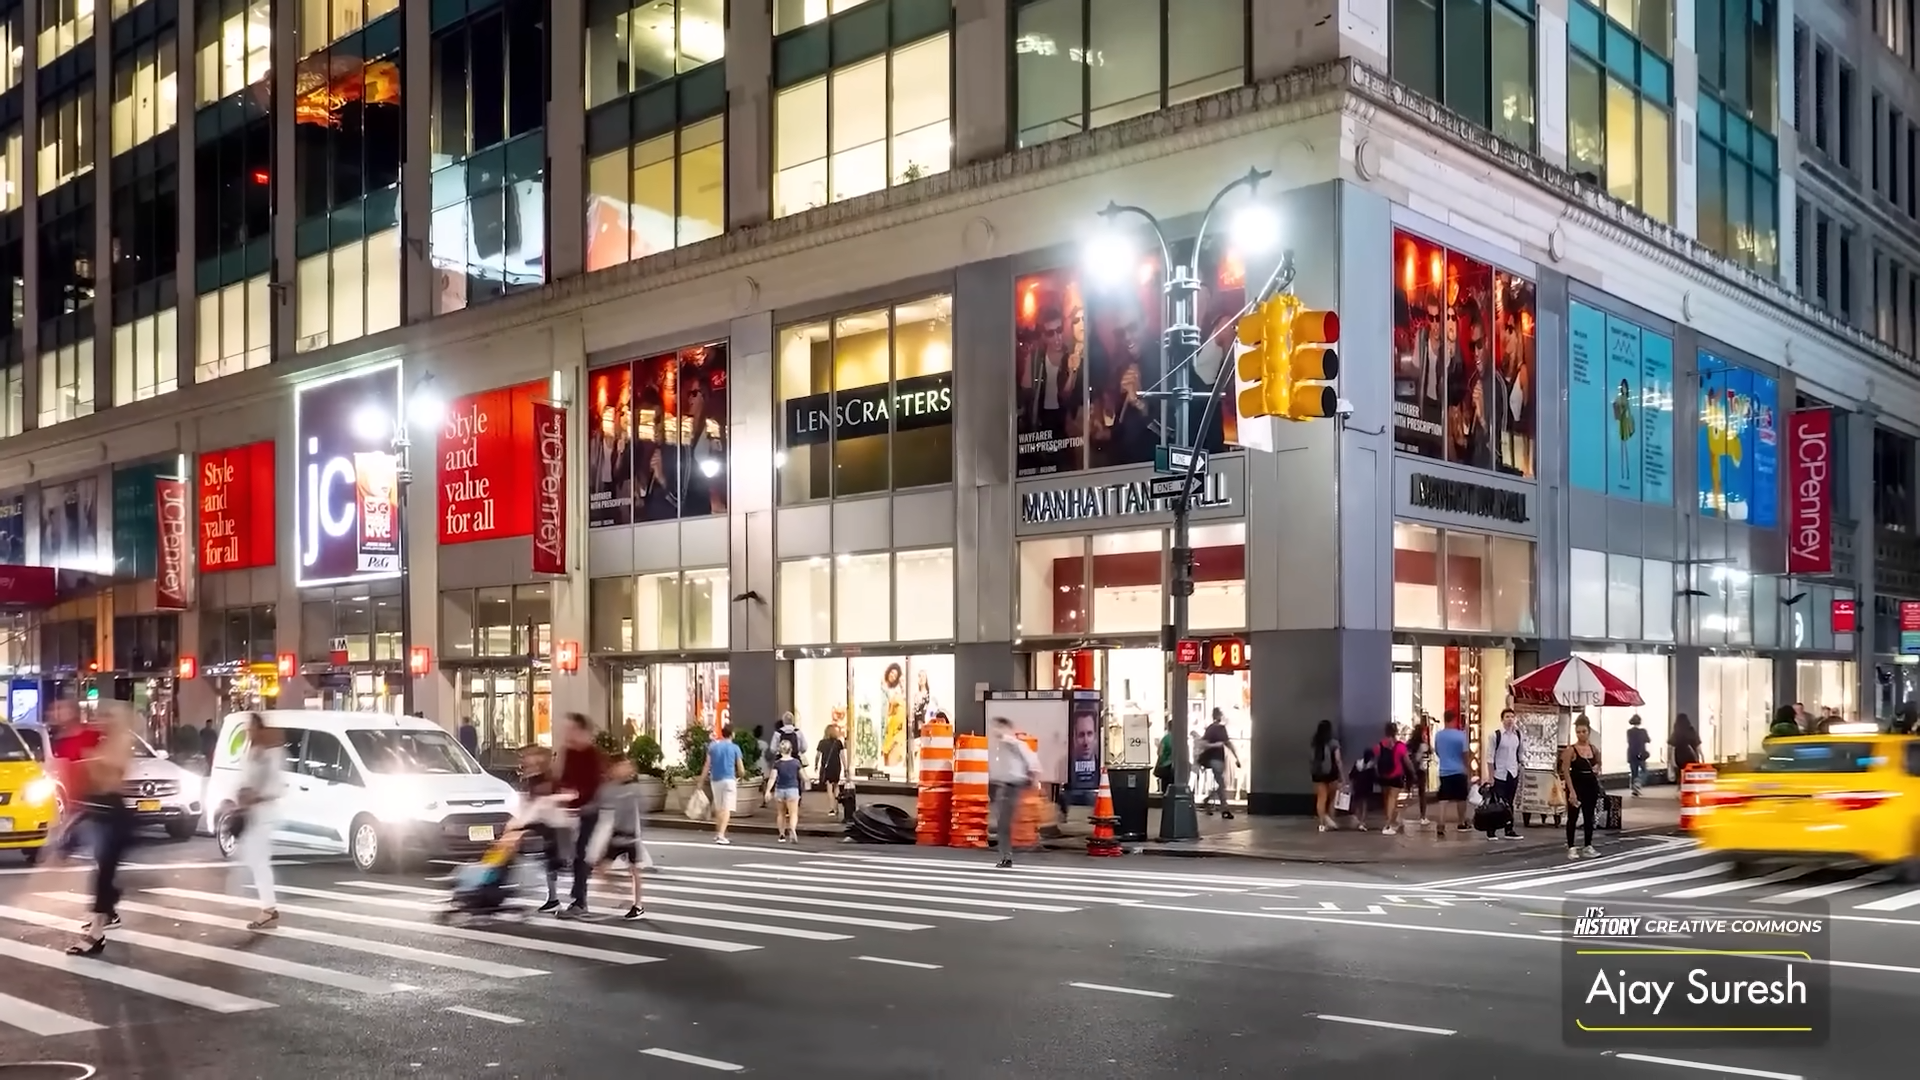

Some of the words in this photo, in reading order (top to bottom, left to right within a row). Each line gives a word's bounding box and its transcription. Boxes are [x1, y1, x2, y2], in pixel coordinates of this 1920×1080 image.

[446, 404, 488, 444] Style
[1019, 430, 1052, 443] WAYFARER
[446, 427, 479, 471] and
[1019, 443, 1035, 454] WITH
[1036, 437, 1084, 452] PRESCRIPTION
[205, 458, 234, 491] Style
[446, 470, 490, 503] value
[536, 422, 563, 557] JCPenney
[1157, 483, 1172, 492] ONE
[205, 485, 227, 512] and
[304, 437, 355, 567] jc
[1793, 424, 1826, 561] JCPenney
[205, 512, 235, 538] value
[446, 504, 470, 535] for
[473, 499, 495, 532] all
[160, 489, 185, 599] JCPenney
[206, 540, 223, 565] for
[224, 536, 238, 563] all
[367, 556, 389, 568] P&G
[1562, 691, 1600, 704] NUTS
